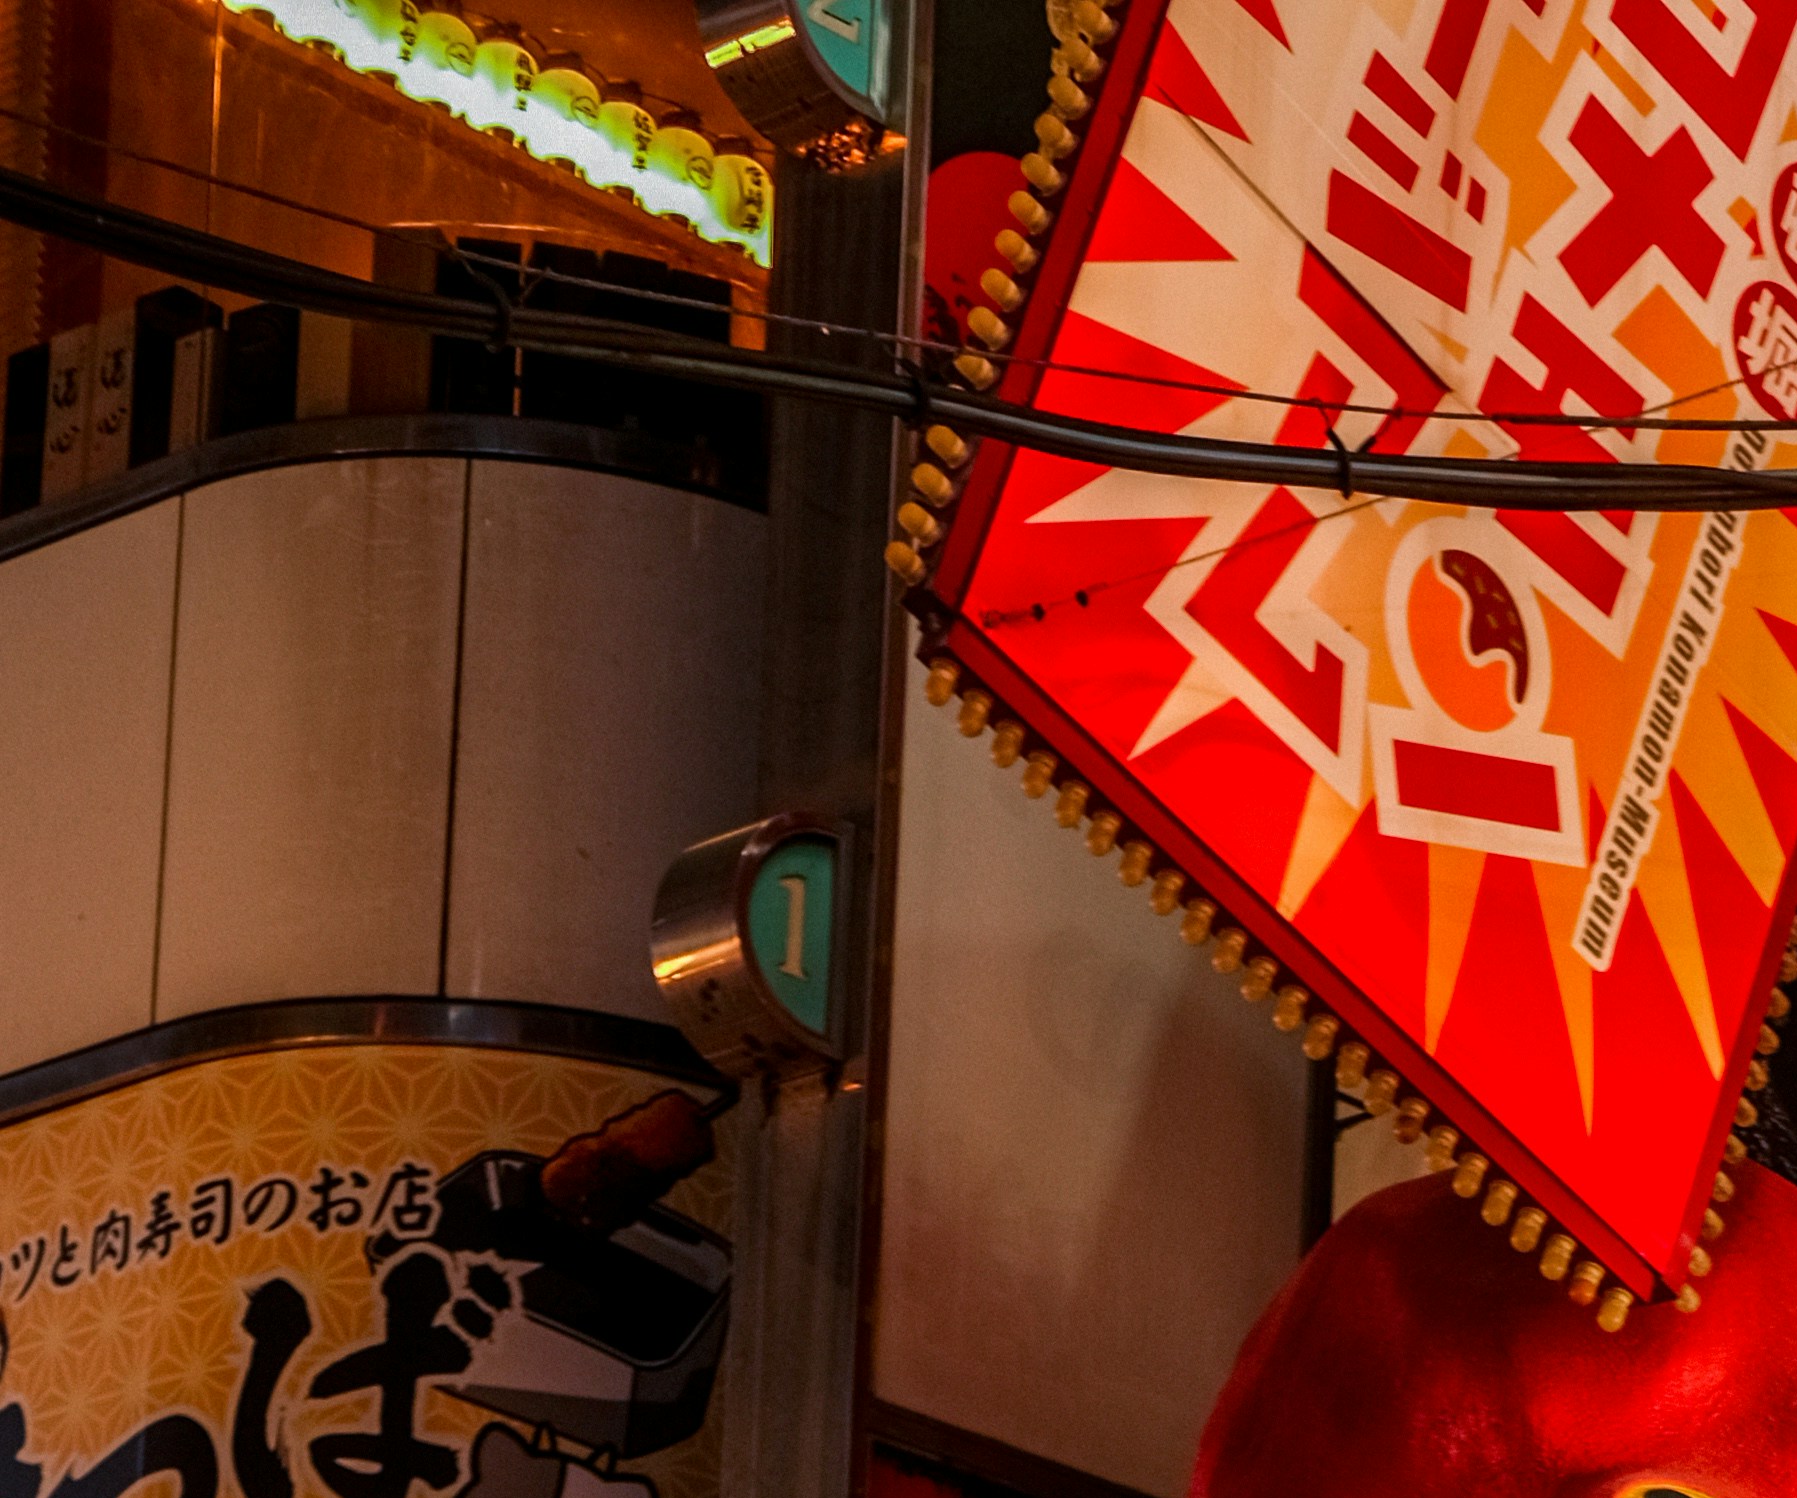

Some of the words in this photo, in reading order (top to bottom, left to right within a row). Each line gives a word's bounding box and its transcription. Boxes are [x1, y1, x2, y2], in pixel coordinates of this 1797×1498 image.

[0, 1162, 435, 1301] ツと肉寿司のお店
